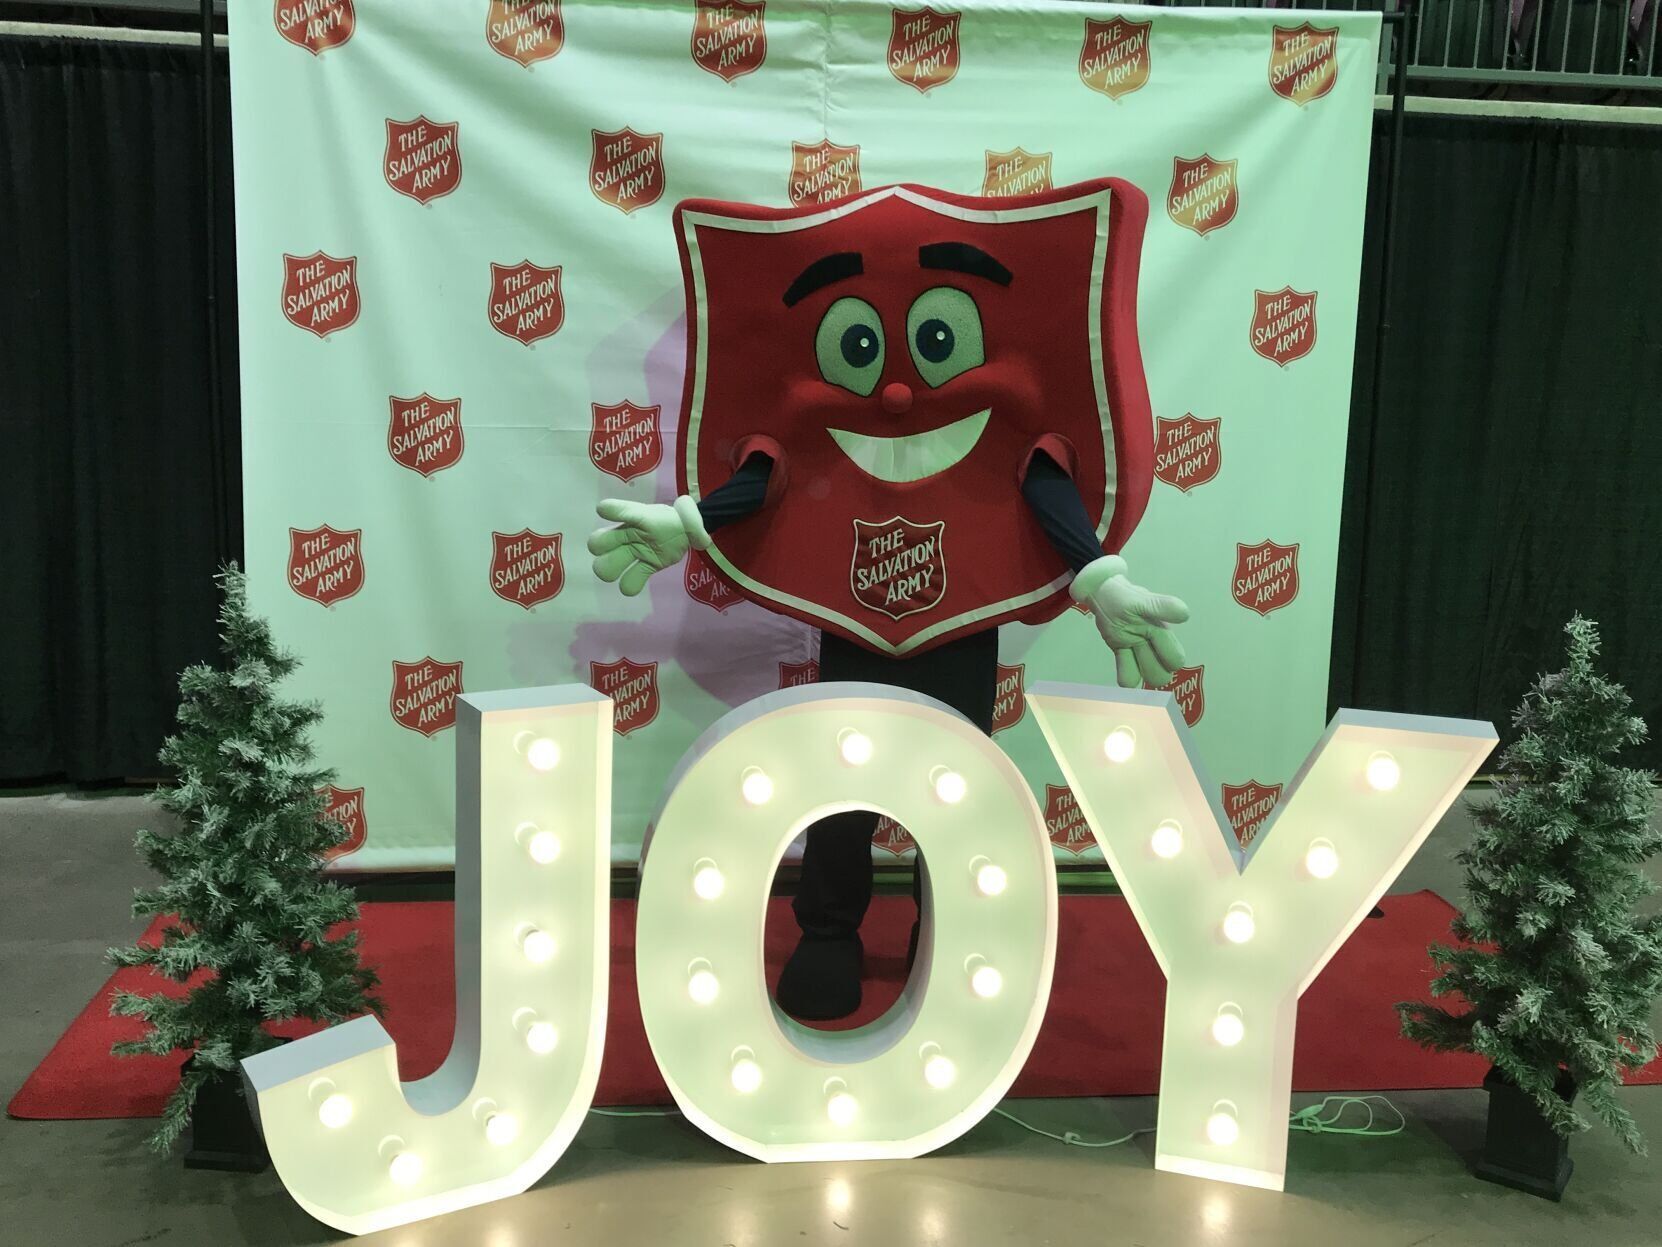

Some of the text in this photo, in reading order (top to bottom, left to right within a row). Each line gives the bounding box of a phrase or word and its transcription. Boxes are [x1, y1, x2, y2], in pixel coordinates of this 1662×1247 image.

[305, 5, 344, 43] ARMY
[492, 0, 555, 43] SALVATION
[696, 9, 759, 58] SALVATION
[706, 4, 734, 28] THE
[903, 16, 930, 40] THE
[516, 20, 553, 55] ARMY
[718, 33, 756, 71] ARMY
[892, 21, 953, 69] SALVATION
[1084, 30, 1144, 78] SALVATION
[1095, 26, 1122, 50] THE
[1283, 32, 1309, 56] THE
[914, 46, 950, 82] ARMY
[1104, 54, 1141, 89] ARMY
[1273, 36, 1332, 84] SALVATION
[1291, 61, 1328, 97] ARMY
[390, 130, 452, 181] SALVATION
[398, 125, 428, 152] THE
[604, 136, 632, 161] THE
[413, 156, 450, 192] ARMY
[595, 141, 656, 190] SALVATION
[794, 152, 853, 201] SALVATION
[803, 148, 830, 173] THE
[995, 156, 1023, 181] THE
[1182, 163, 1209, 188] THE
[617, 166, 654, 202] ARMY
[1172, 167, 1231, 215] SALVATION
[1193, 191, 1228, 225] ARMY
[287, 265, 350, 315] SALVATION
[295, 261, 325, 287] THE
[503, 269, 531, 295] THE
[310, 290, 349, 327] ARMY
[493, 274, 555, 323] SALVATION
[1265, 295, 1292, 320] THE
[516, 299, 554, 335] ARMY
[1255, 299, 1311, 347] SALVATION
[1273, 322, 1308, 358] ARMY
[393, 407, 455, 455] SALVATION
[402, 402, 430, 427] THE
[603, 410, 630, 434] THE
[415, 431, 453, 467] ARMY
[594, 414, 654, 461] SALVATION
[1156, 426, 1214, 472] SALVATION
[1166, 422, 1193, 446] THE
[616, 437, 652, 471] ARMY
[1175, 448, 1211, 482] ARMY
[301, 534, 330, 558] THE
[504, 537, 531, 561] THE
[869, 527, 905, 558] THE
[1246, 547, 1271, 571] THE
[293, 538, 355, 586] SALVATION
[315, 561, 354, 597] ARMY
[495, 541, 555, 589] SALVATION
[857, 536, 936, 592] SALVATION
[1236, 551, 1293, 597] SALVATION
[517, 564, 554, 600] ARMY
[885, 564, 934, 606] ARMY
[1255, 572, 1290, 606] ARMY
[395, 669, 456, 718] SALVATION
[405, 665, 432, 690] THE
[602, 666, 629, 690] THE
[418, 692, 456, 727] ARMY
[614, 691, 650, 726] ARMY
[1056, 792, 1077, 811] TH
[1230, 790, 1277, 829] ALVATION
[1231, 787, 1256, 810] THE
[1066, 822, 1091, 846] ARM
[242, 680, 1497, 1236] JOY
